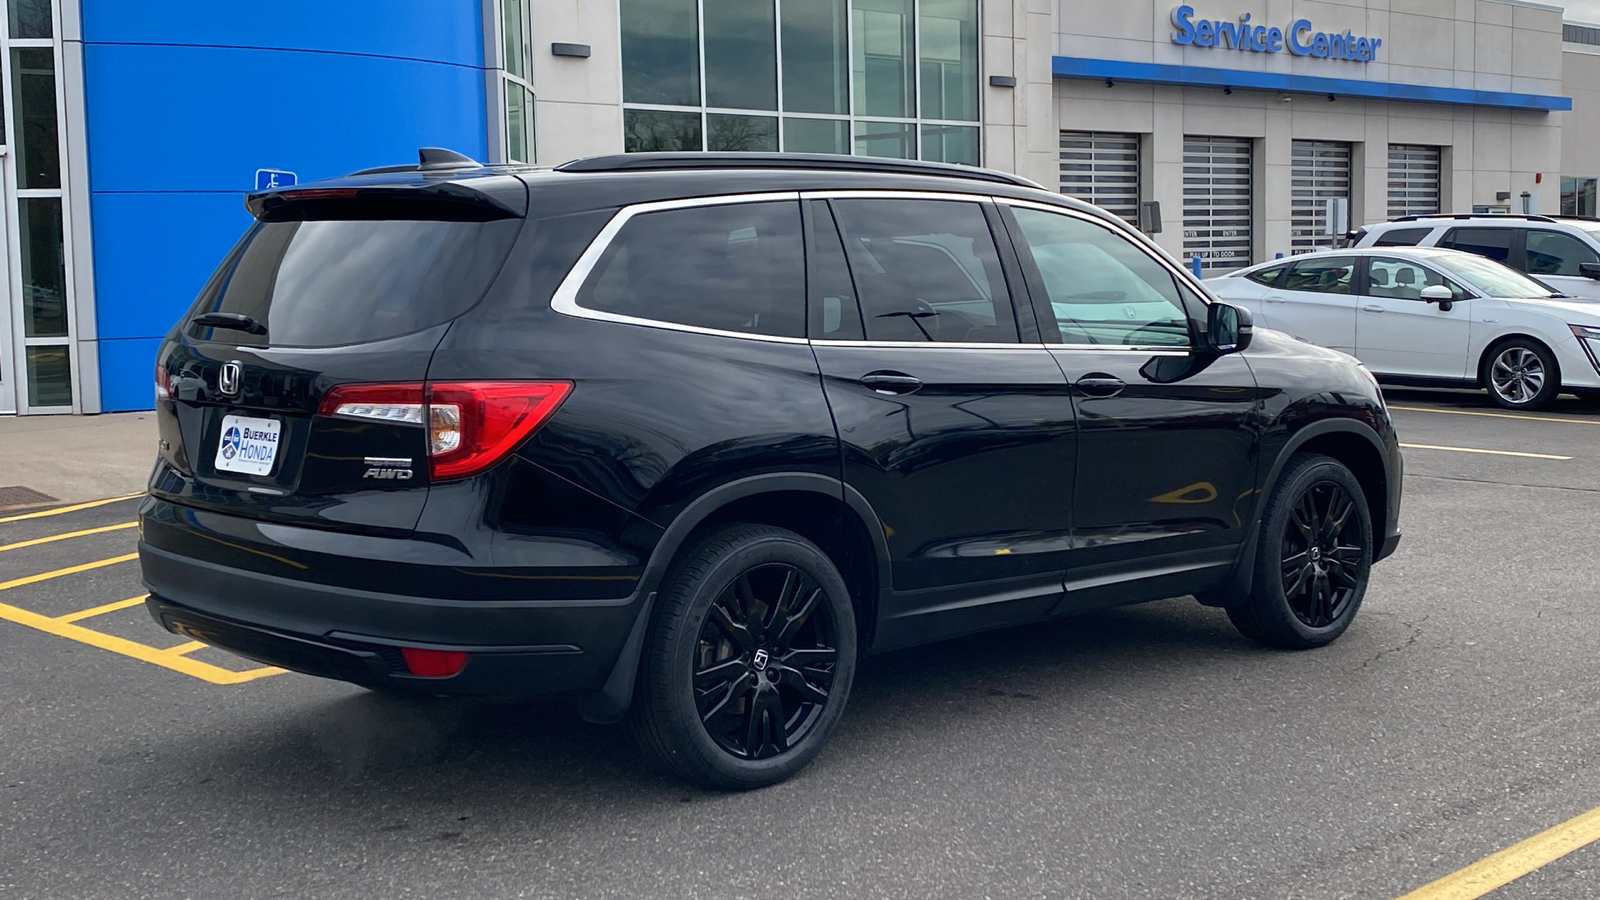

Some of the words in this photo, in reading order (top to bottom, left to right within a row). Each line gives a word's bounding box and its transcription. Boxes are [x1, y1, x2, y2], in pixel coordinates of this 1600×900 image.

[1171, 4, 1282, 53] Service
[1286, 19, 1382, 62] Center
[1212, 250, 1220, 258] TO
[243, 427, 278, 443] BUERKLE
[239, 440, 273, 461] HONDA
[362, 468, 413, 479] AWD
